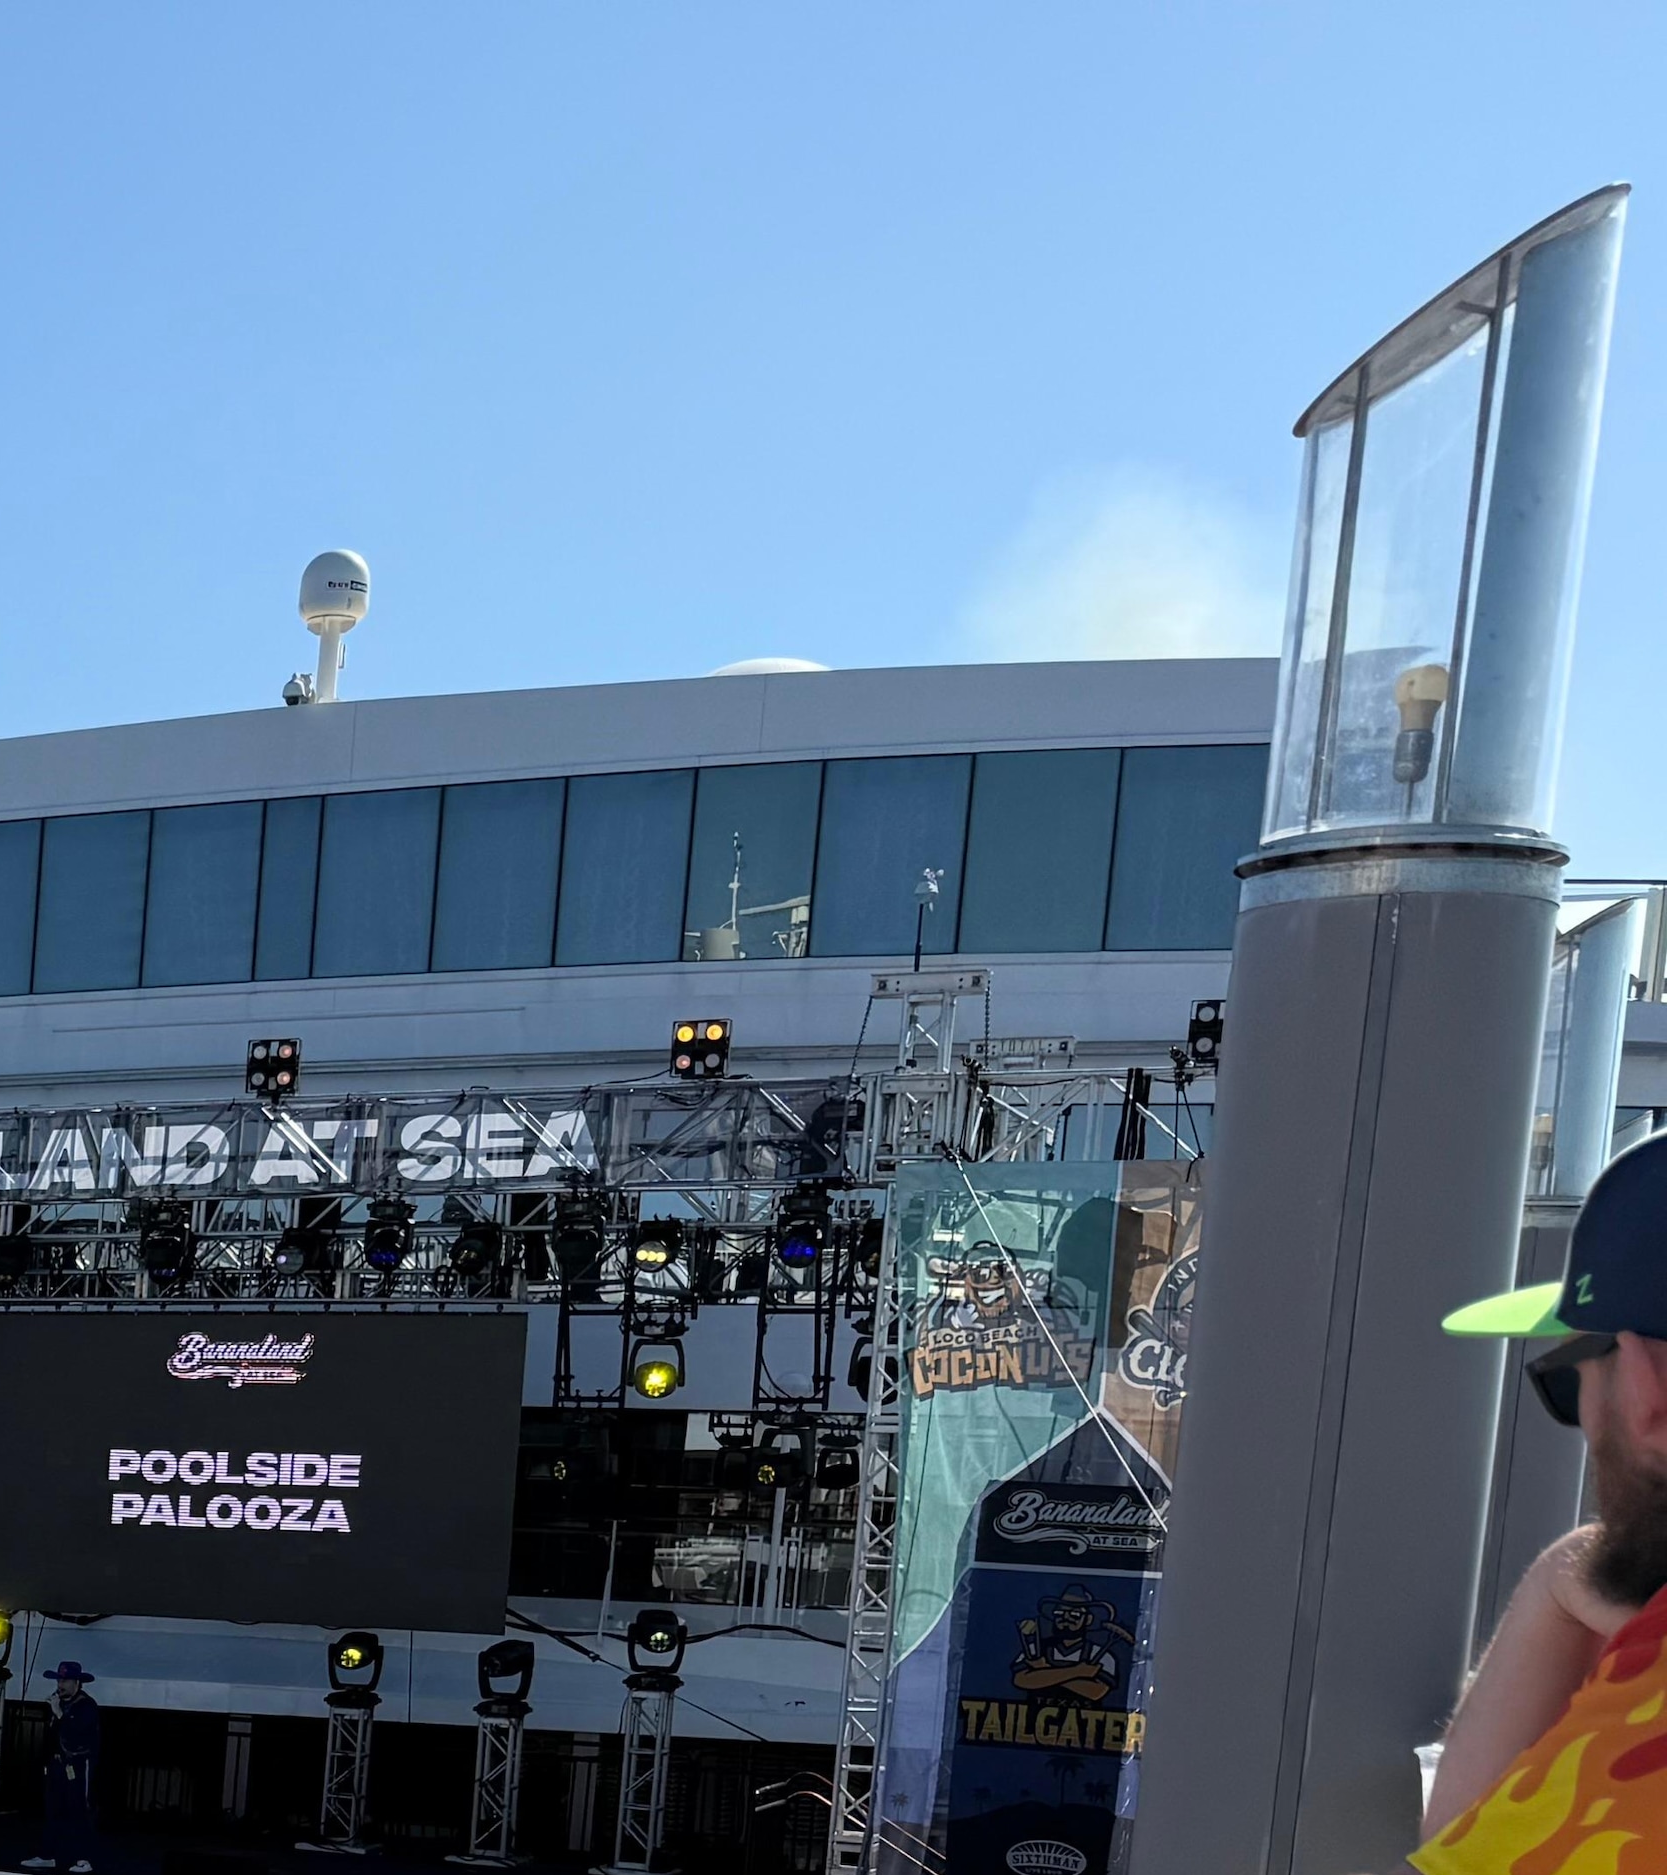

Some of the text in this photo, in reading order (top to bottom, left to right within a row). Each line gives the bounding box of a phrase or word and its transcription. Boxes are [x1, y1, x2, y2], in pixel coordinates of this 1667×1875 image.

[250, 1119, 378, 1186] AT
[396, 1110, 601, 1183] SEA
[168, 1332, 315, 1374] Bananaland
[932, 1325, 1039, 1346] LOCO BEACH
[108, 1449, 362, 1487] POOLSIDE
[111, 1494, 351, 1533] PALOOZA
[1000, 1490, 1171, 1530] Bananaland
[1092, 1536, 1139, 1547] AT SEA
[1012, 1853, 1081, 1870] SIXTHMAN
